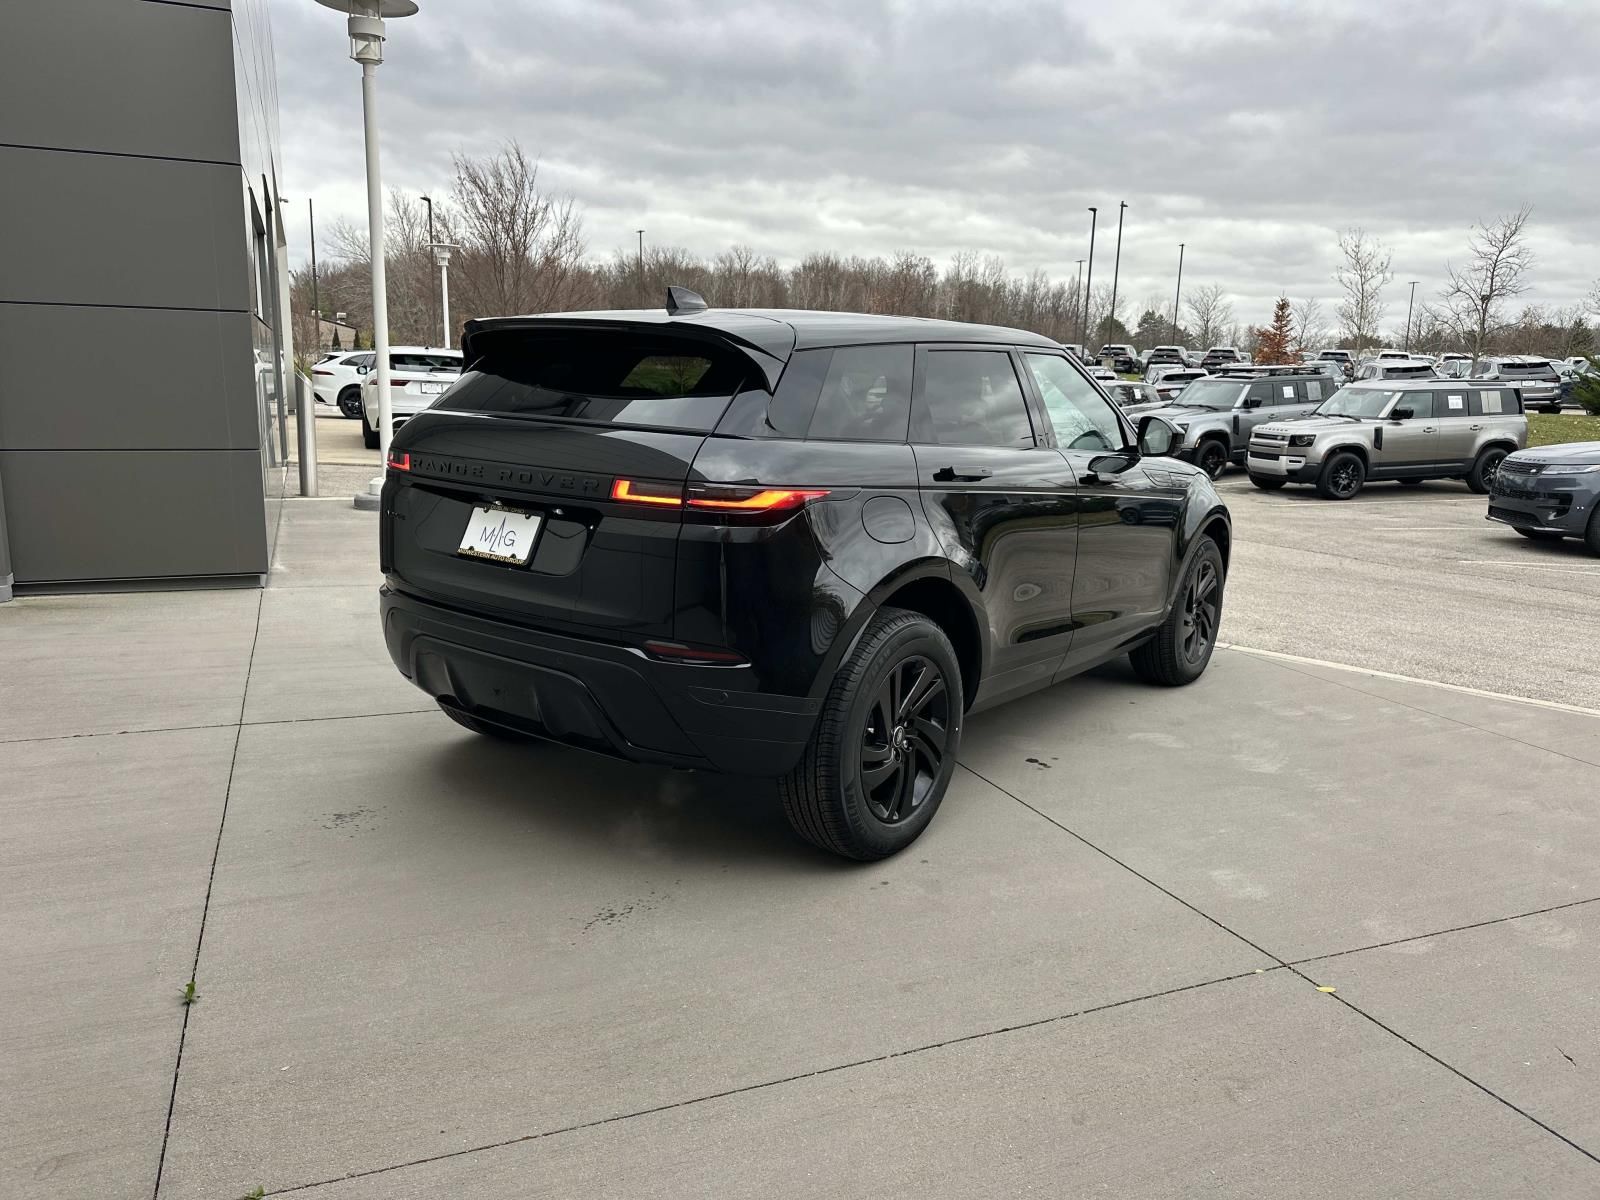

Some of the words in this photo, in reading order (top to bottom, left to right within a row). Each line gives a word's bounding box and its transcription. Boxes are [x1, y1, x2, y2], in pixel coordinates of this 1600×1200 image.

[412, 458, 484, 478] RANGE
[499, 470, 600, 493] ROVER
[490, 553, 505, 561] AUTO
[505, 556, 524, 564] GROUP
